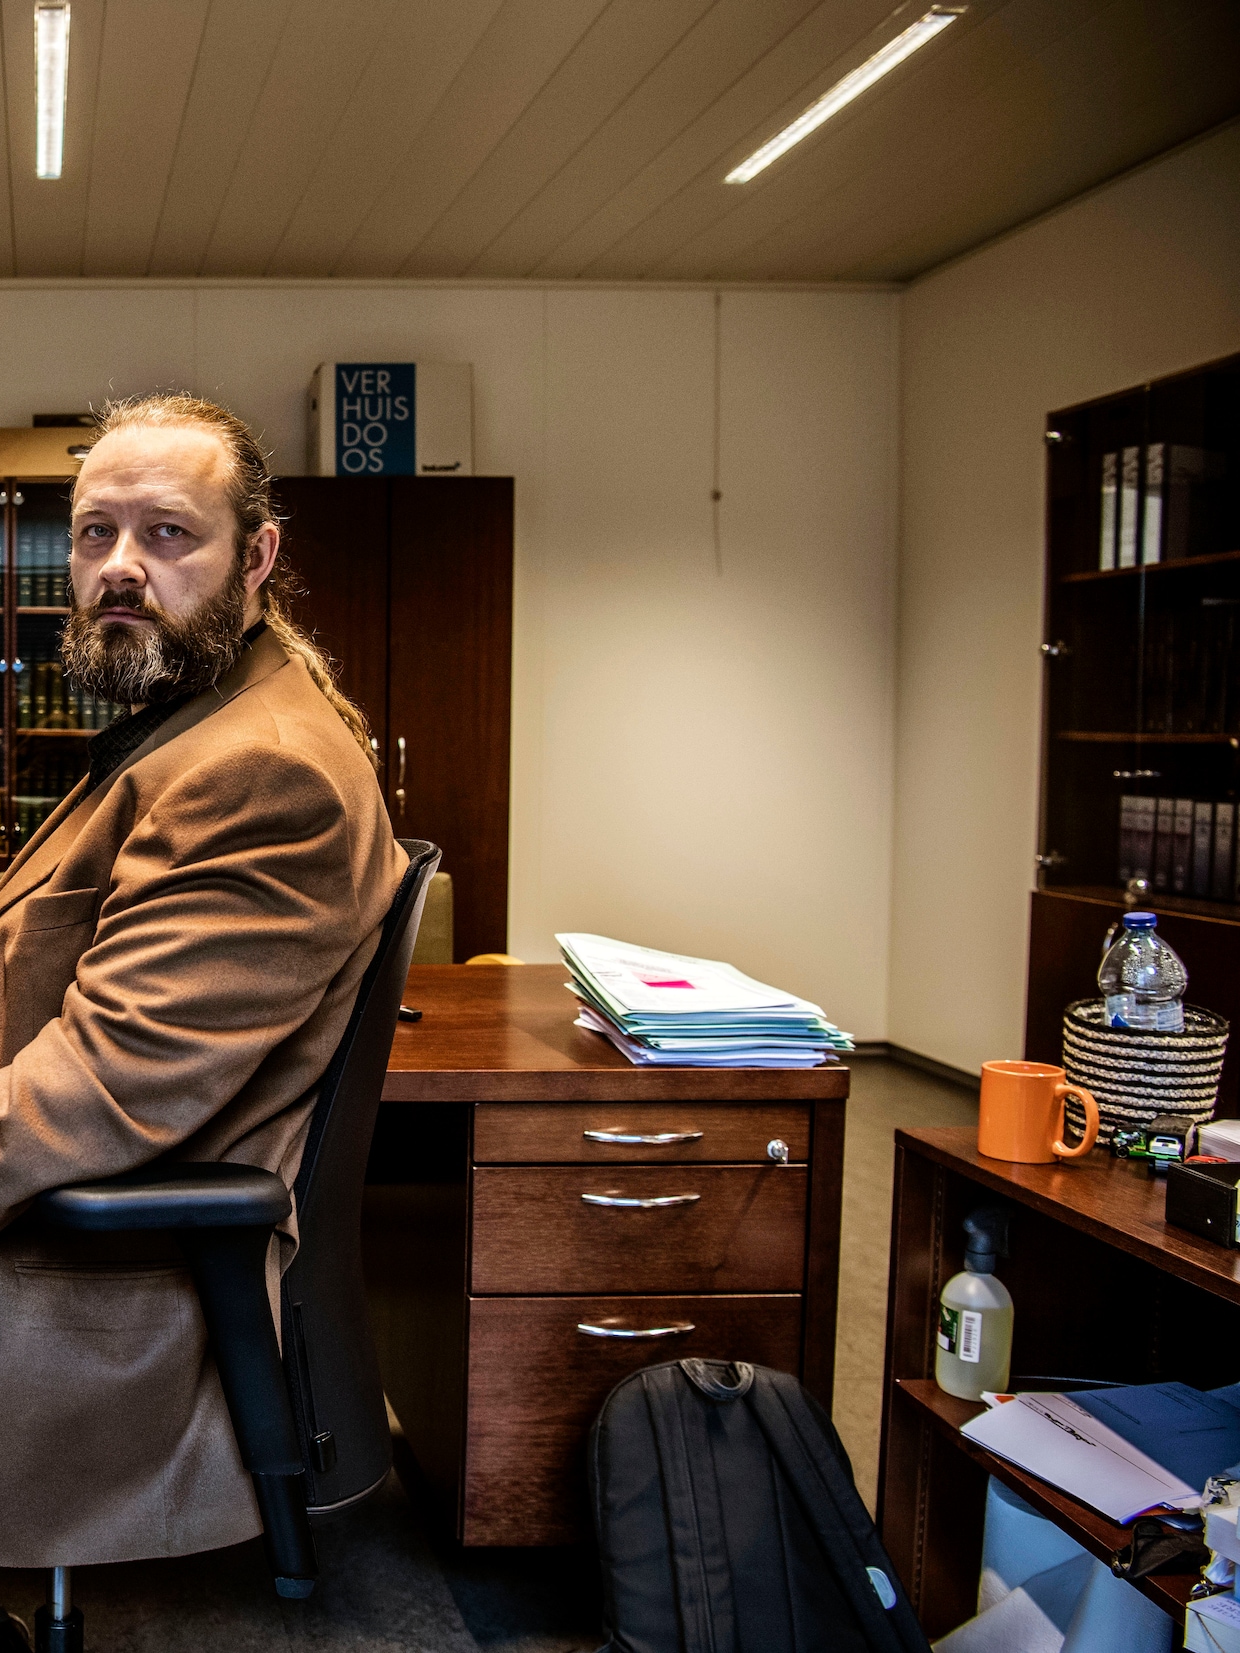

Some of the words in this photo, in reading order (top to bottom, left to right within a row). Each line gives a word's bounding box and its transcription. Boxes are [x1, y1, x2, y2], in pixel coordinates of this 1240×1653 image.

[341, 370, 391, 394] VER
[342, 396, 409, 420] HUIS
[342, 422, 388, 447] DO
[342, 448, 384, 473] OS
